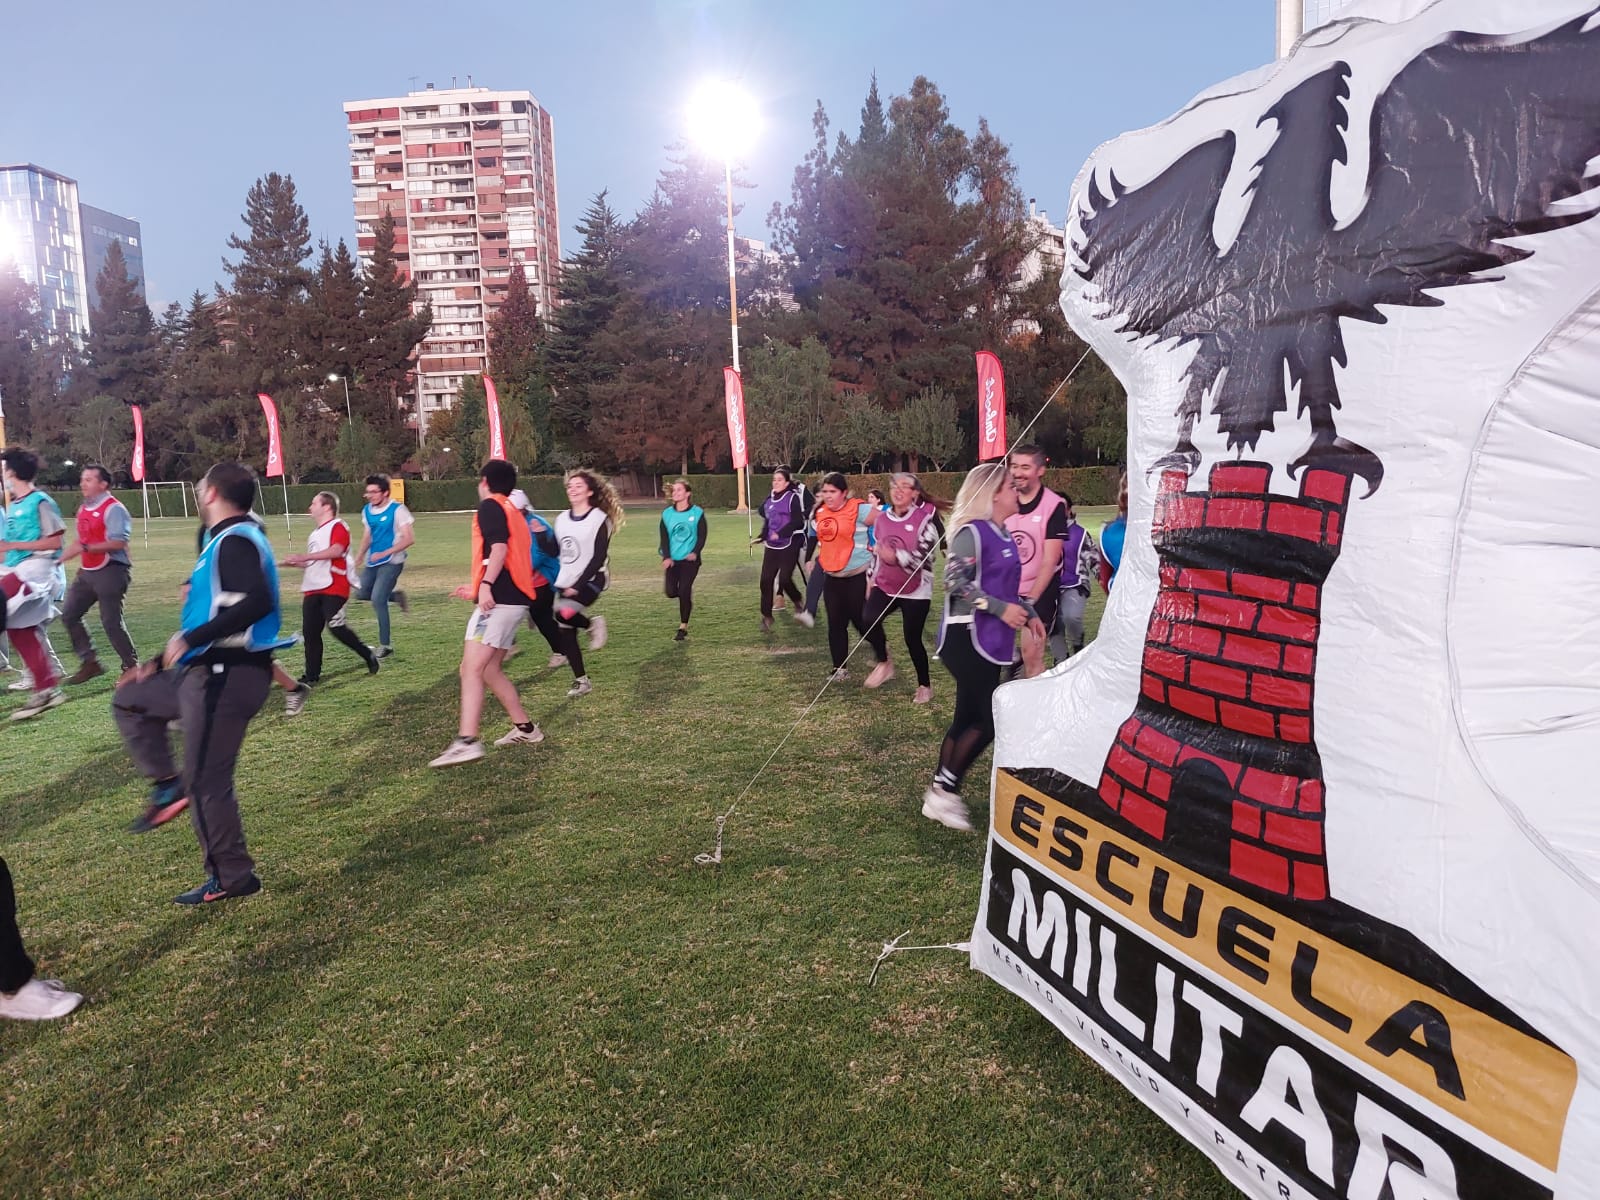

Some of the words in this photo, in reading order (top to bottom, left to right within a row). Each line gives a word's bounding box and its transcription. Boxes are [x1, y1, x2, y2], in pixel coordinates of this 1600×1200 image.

[1006, 867, 1461, 1200] MILITAR
[1010, 793, 1466, 1101] ESCUELA
[1180, 1100, 1190, 1118] Y
